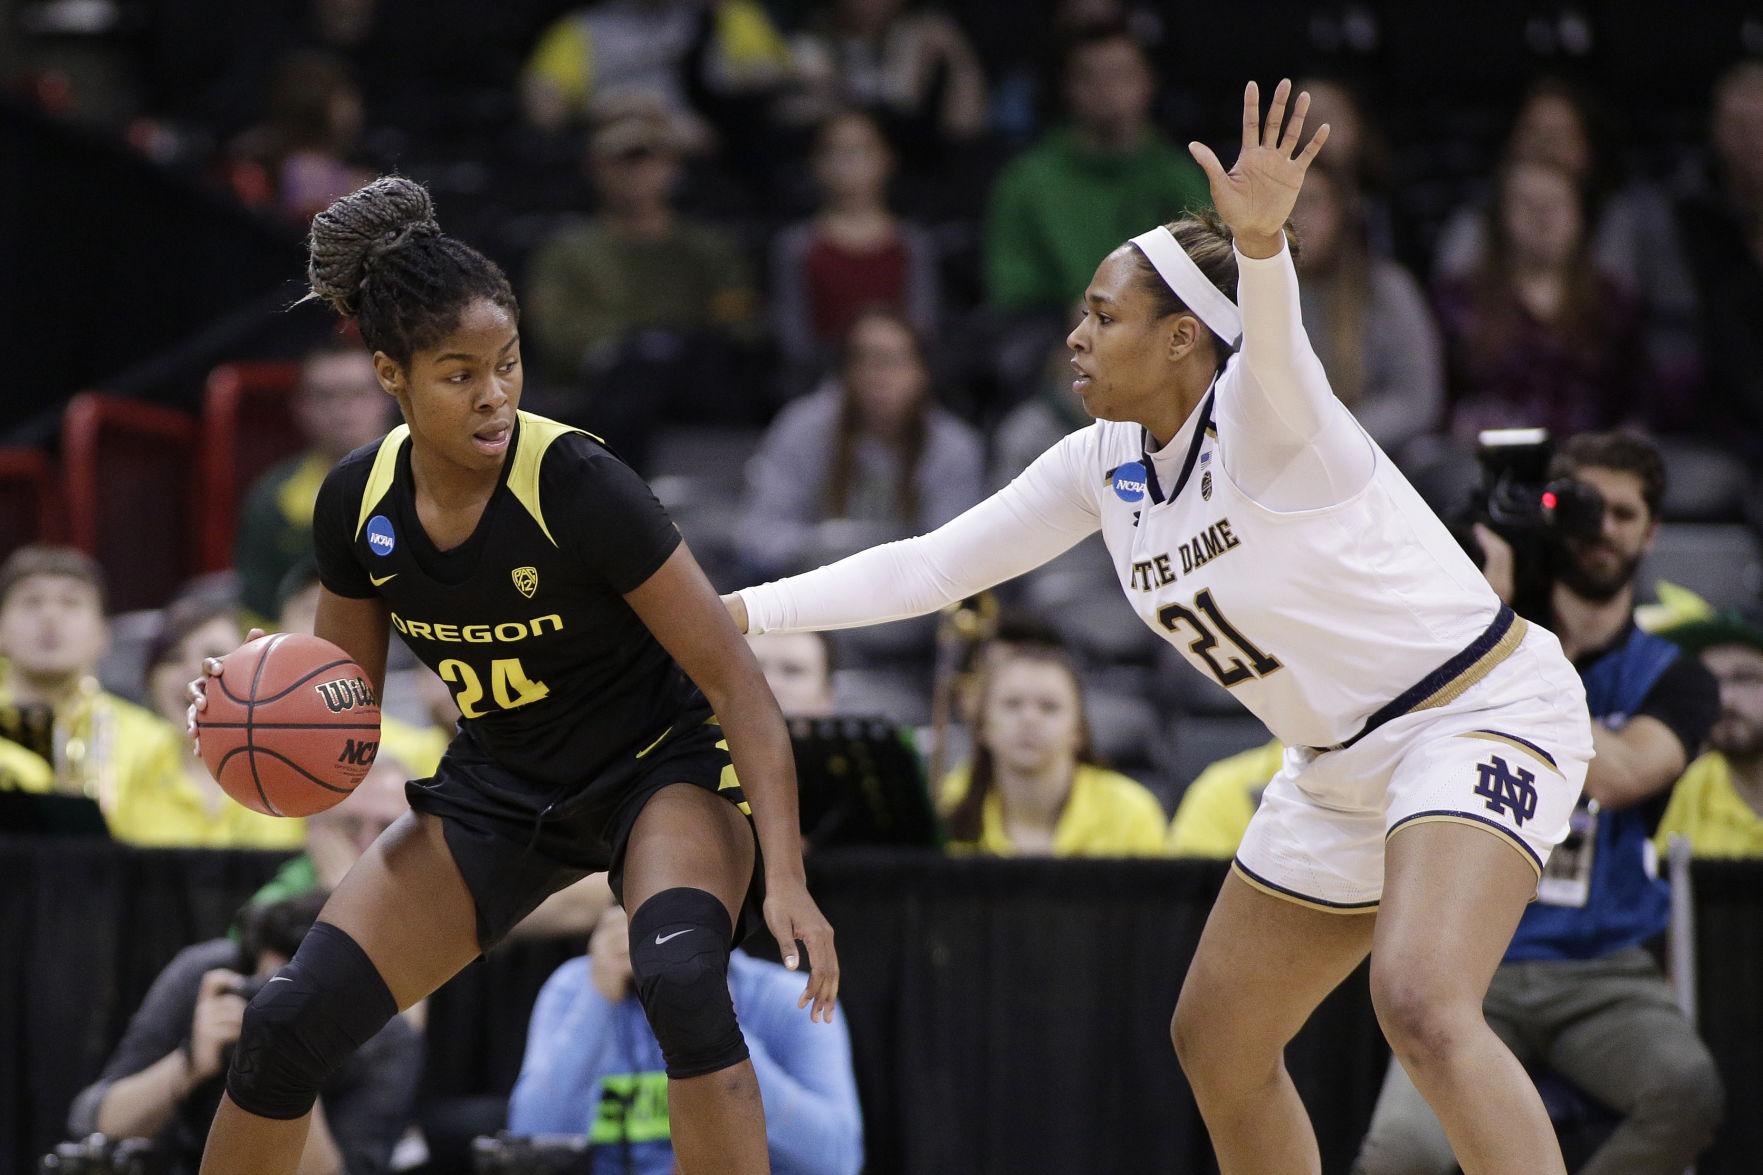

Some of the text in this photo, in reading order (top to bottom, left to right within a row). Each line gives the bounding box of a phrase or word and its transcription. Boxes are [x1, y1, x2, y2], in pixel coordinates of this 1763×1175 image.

[370, 532, 393, 549] NCAA
[1178, 517, 1242, 576] DAME
[514, 568, 536, 587] PAC
[521, 579, 534, 592] 12
[390, 611, 564, 643] OREGON
[1157, 586, 1285, 688] 21
[438, 658, 550, 719] 24
